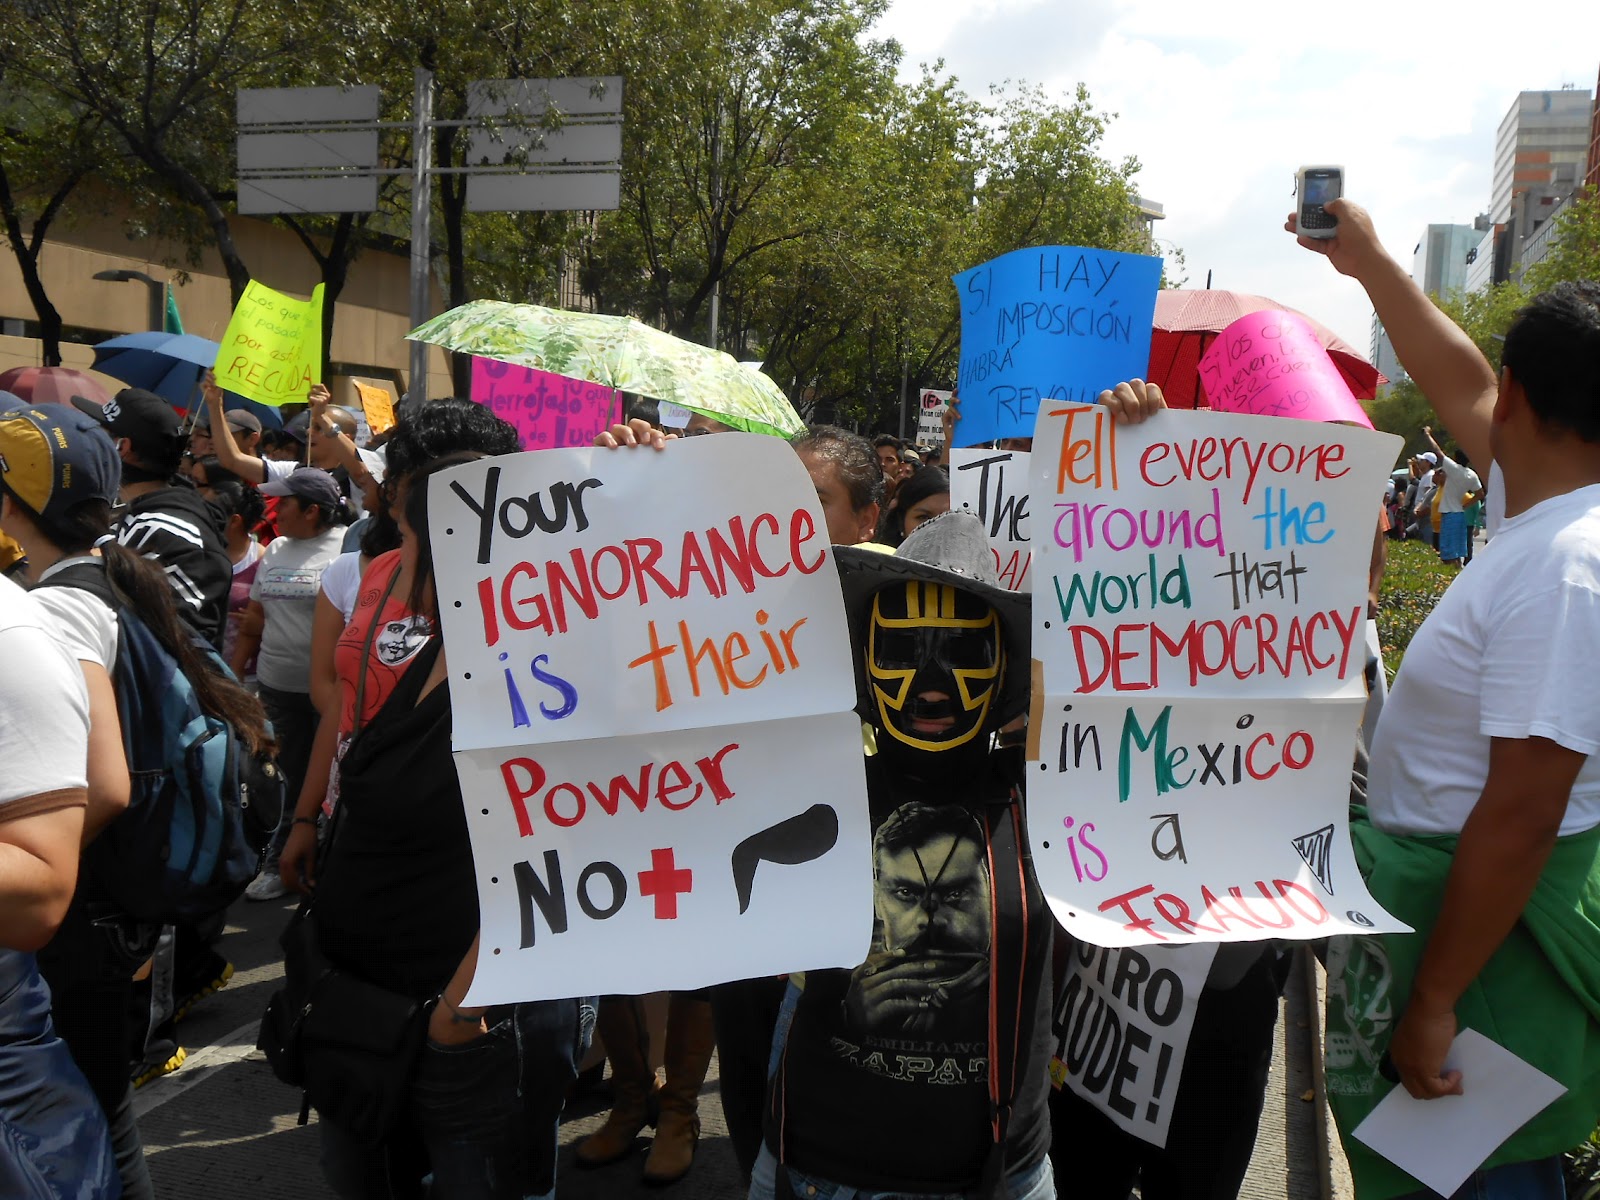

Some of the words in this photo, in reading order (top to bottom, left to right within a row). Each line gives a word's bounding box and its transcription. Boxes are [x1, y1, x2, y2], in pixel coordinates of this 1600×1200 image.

[1039, 253, 1121, 297] HAY
[957, 453, 1031, 542] The
[1048, 406, 1119, 494] Tell
[1139, 436, 1351, 505] everyone
[449, 467, 603, 564] Your
[1053, 487, 1225, 563] around
[1252, 486, 1335, 550] the
[1213, 551, 1307, 610] that
[498, 652, 578, 728] is
[627, 608, 808, 712] their
[1068, 605, 1362, 694] DEMOCRACY
[500, 743, 740, 837] Power
[1058, 704, 1102, 773] in
[1118, 705, 1315, 803] Mexico
[1063, 816, 1109, 883] is
[1149, 813, 1188, 864] a
